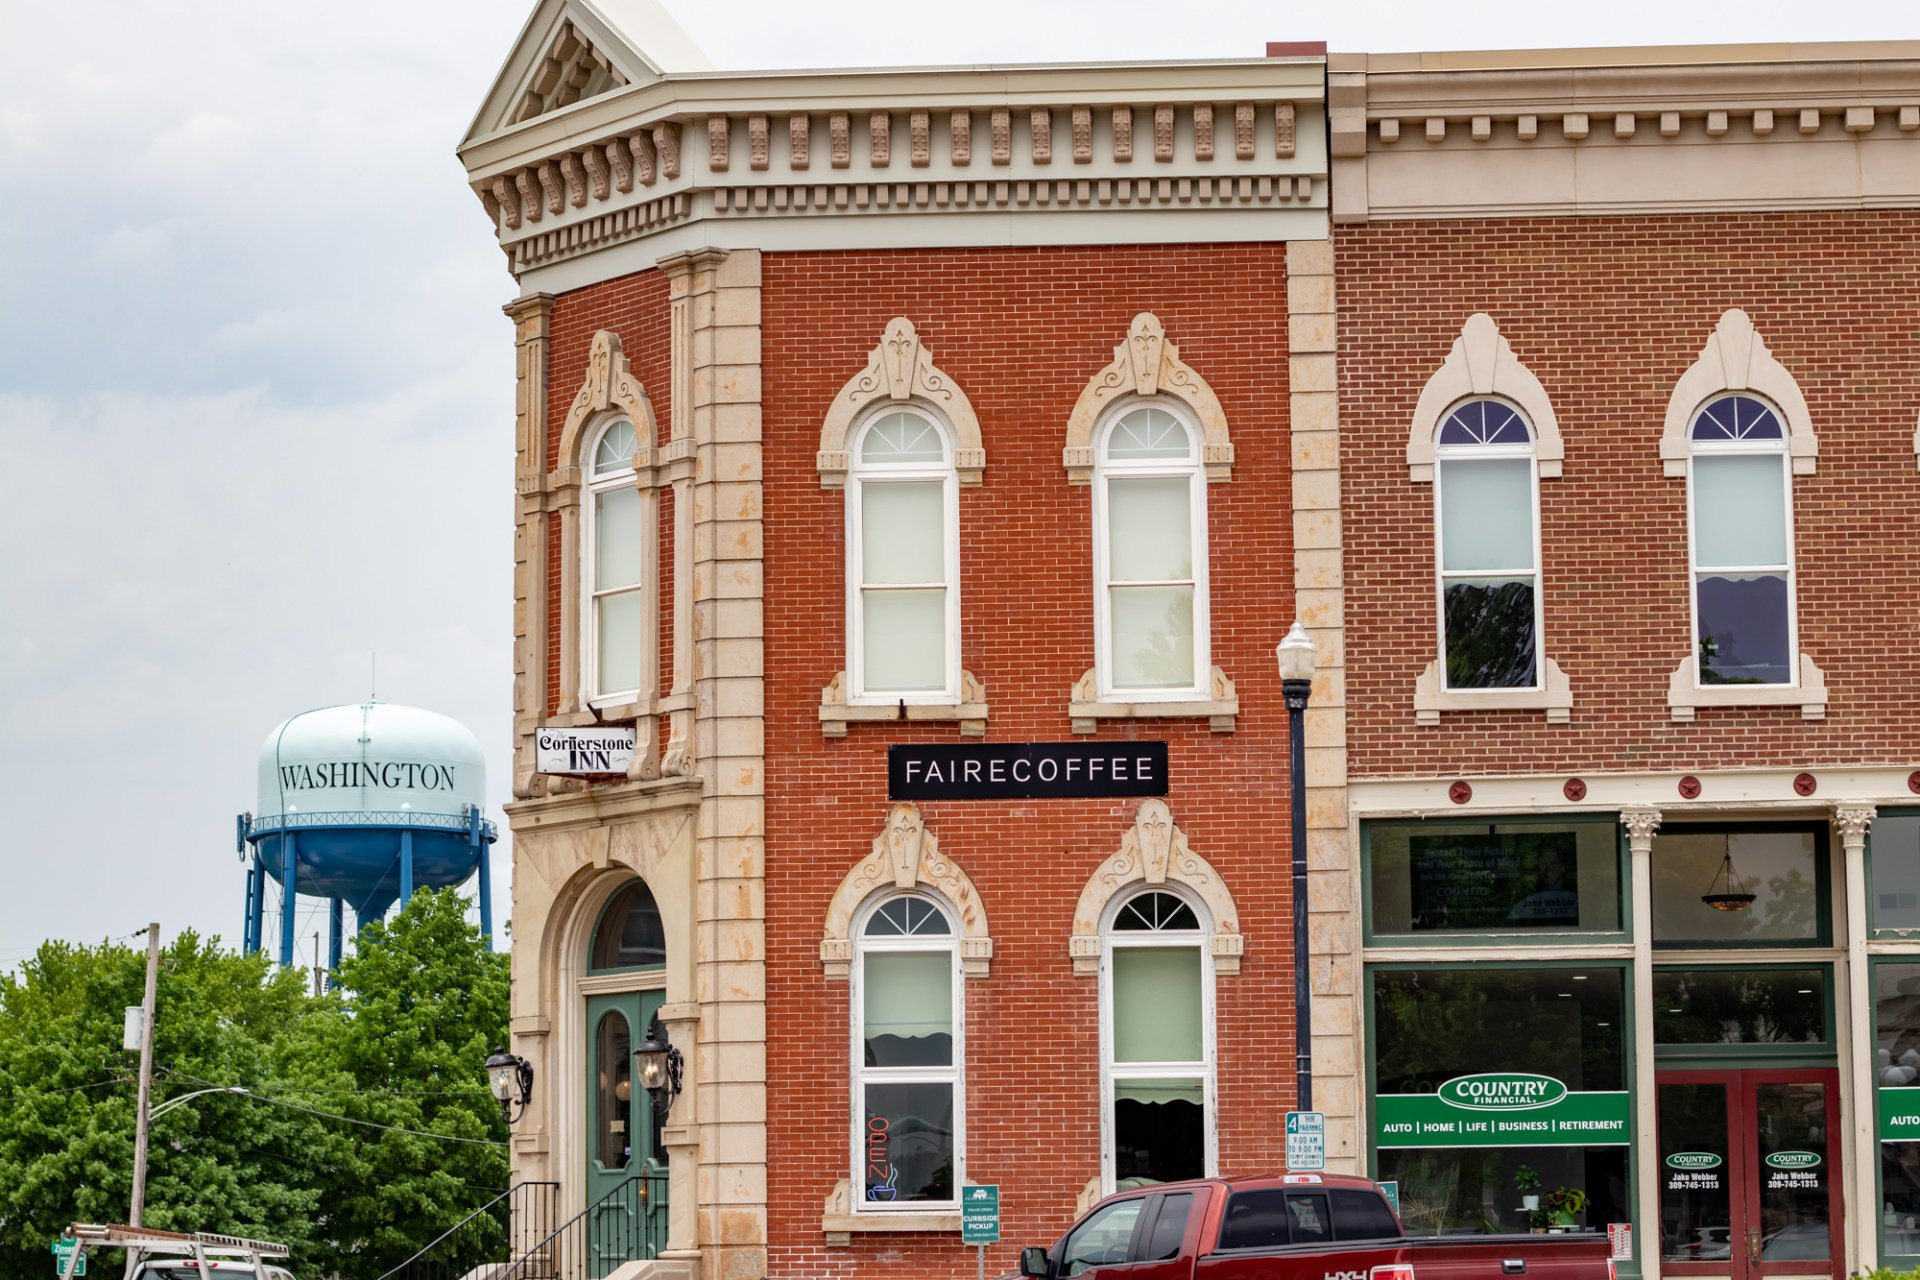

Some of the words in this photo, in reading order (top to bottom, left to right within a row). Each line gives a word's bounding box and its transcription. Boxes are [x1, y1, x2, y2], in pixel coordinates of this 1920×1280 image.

[540, 736, 634, 751] Cornerstone
[569, 736, 611, 771] INN
[280, 761, 456, 791] WASHINGTON
[1436, 887, 1490, 898] COUNTRY
[1455, 1080, 1549, 1097] COUNTRY
[1288, 1117, 1297, 1131] 4
[1889, 1115, 1920, 1126] AUTO
[1383, 1123, 1412, 1133] AUTO
[1423, 1123, 1455, 1132] HOME
[1466, 1122, 1487, 1131] LIFE
[1498, 1121, 1549, 1131] BUSINESS
[1559, 1120, 1624, 1130] RETIREMENT
[1309, 1136, 1318, 1144] AM
[868, 1117, 889, 1178] OPEN
[1288, 1145, 1296, 1153] TO
[1313, 1145, 1323, 1153] PM
[1673, 1156, 1714, 1164] COUNTRY
[1772, 1154, 1813, 1163] COUNTRY
[1672, 1173, 1690, 1181] Jake
[1691, 1173, 1717, 1181] Webber
[1771, 1172, 1789, 1180] Jake
[1790, 1172, 1816, 1180] Webber
[1668, 1181, 1719, 1190] 309-745-1313
[1767, 1180, 1818, 1189] 309-745-1313
